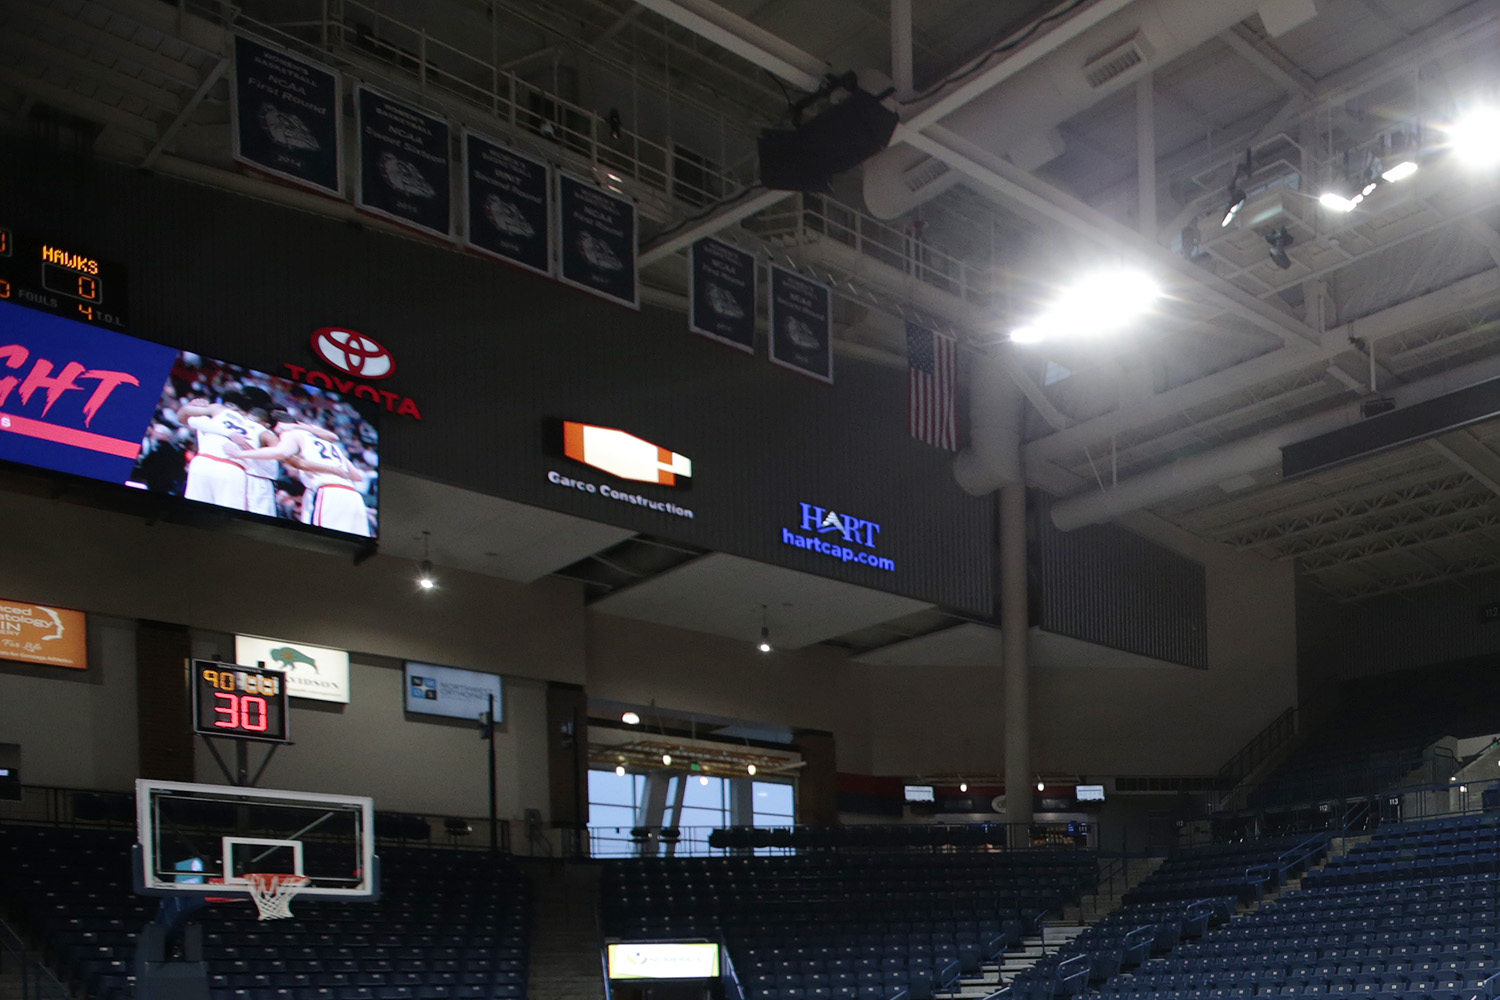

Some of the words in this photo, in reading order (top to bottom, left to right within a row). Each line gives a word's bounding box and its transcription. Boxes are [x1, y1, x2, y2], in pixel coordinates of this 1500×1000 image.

[248, 77, 279, 96] First
[281, 91, 328, 115] Round
[268, 74, 307, 95] NCAA
[42, 244, 100, 275] HAWKS
[18, 289, 58, 308] FOULS
[78, 275, 96, 300] 0
[78, 303, 93, 321] 4
[283, 362, 423, 420] TOYOTA
[548, 470, 597, 494] Garco
[599, 484, 694, 519] Construction
[799, 502, 881, 549] HART
[782, 528, 895, 572] hartcap.com
[285, 675, 340, 690] VIDSON
[213, 692, 268, 732] 30
[1319, 803, 1329, 812] 112
[1388, 797, 1399, 806] 113
